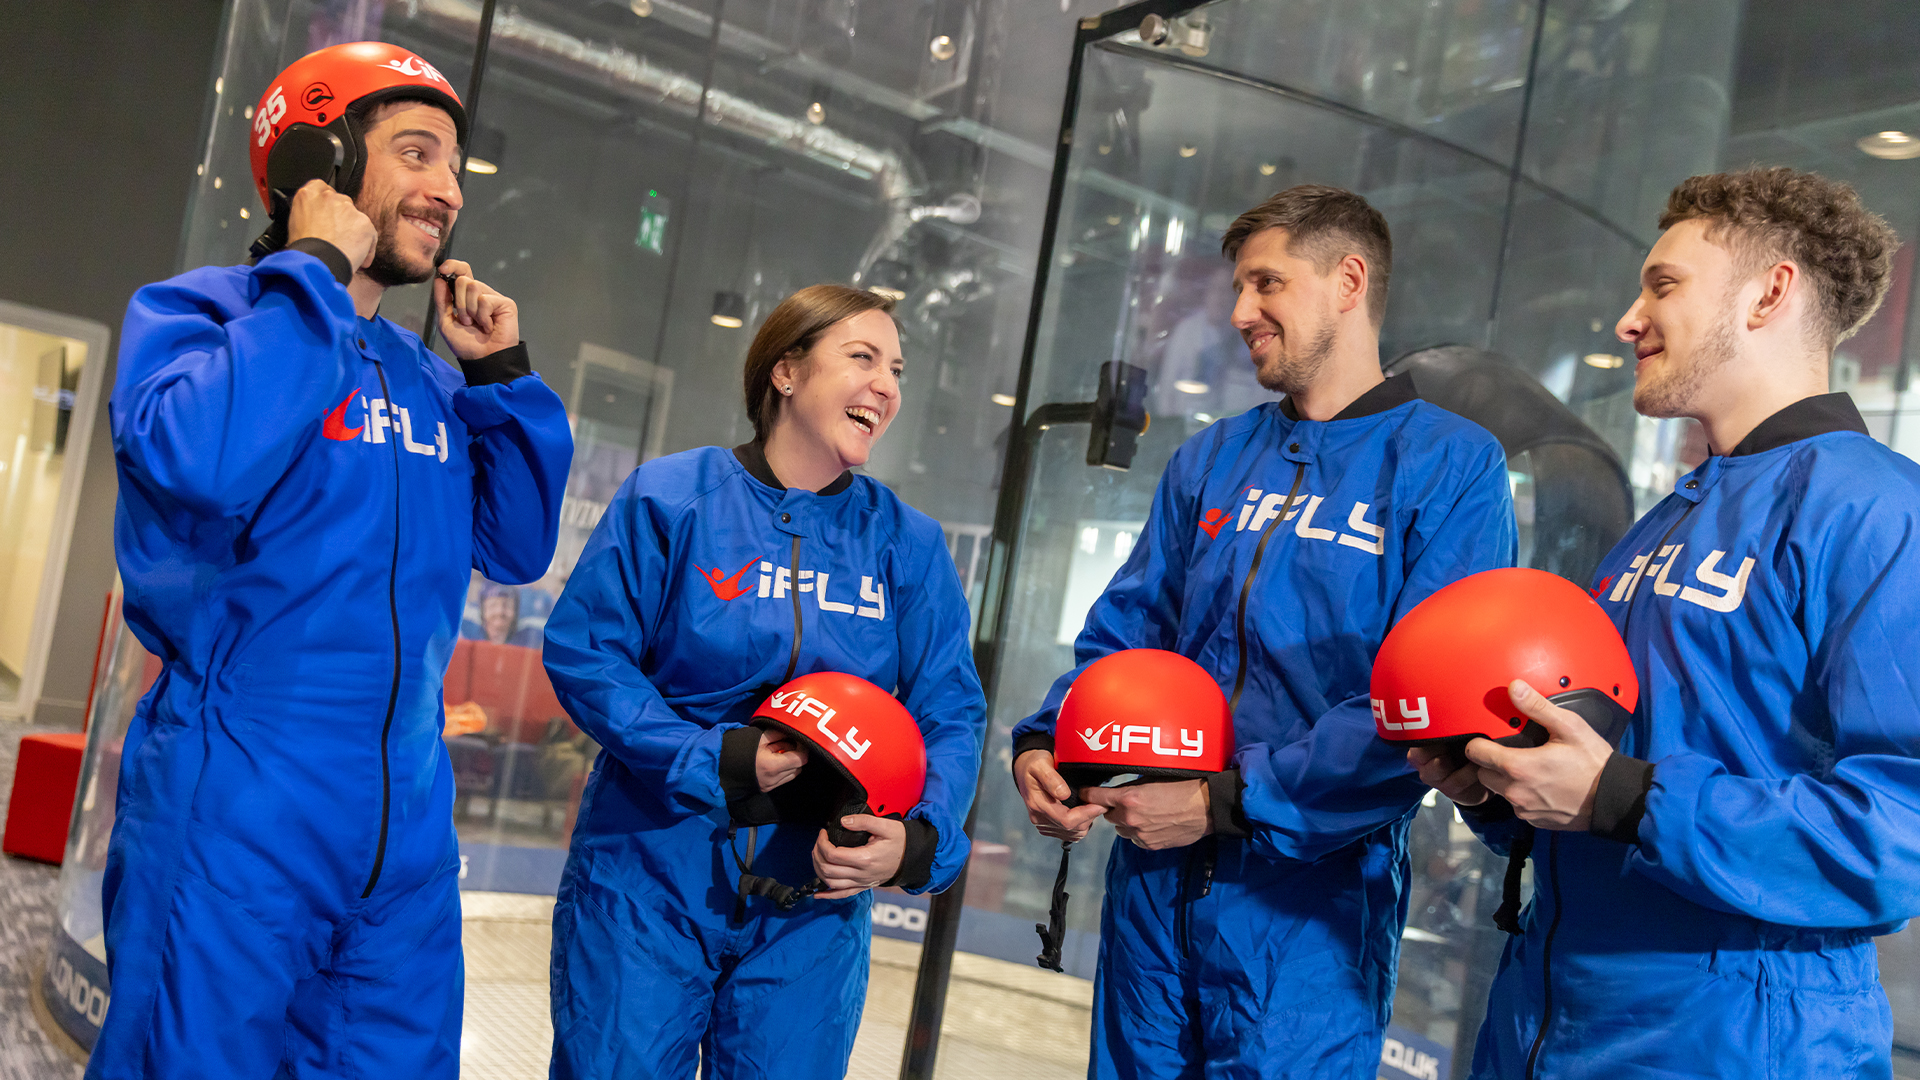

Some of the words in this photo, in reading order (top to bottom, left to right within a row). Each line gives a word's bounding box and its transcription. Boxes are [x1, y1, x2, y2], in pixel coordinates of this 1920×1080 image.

[255, 86, 287, 147] 35
[1236, 489, 1385, 555] iFLY
[757, 561, 885, 621] iFLY
[1608, 543, 1756, 613] iFLY
[785, 693, 872, 760] iFLY
[1111, 725, 1203, 757] iFLY
[1371, 697, 1429, 730] FLY
[872, 902, 928, 932] NDO
